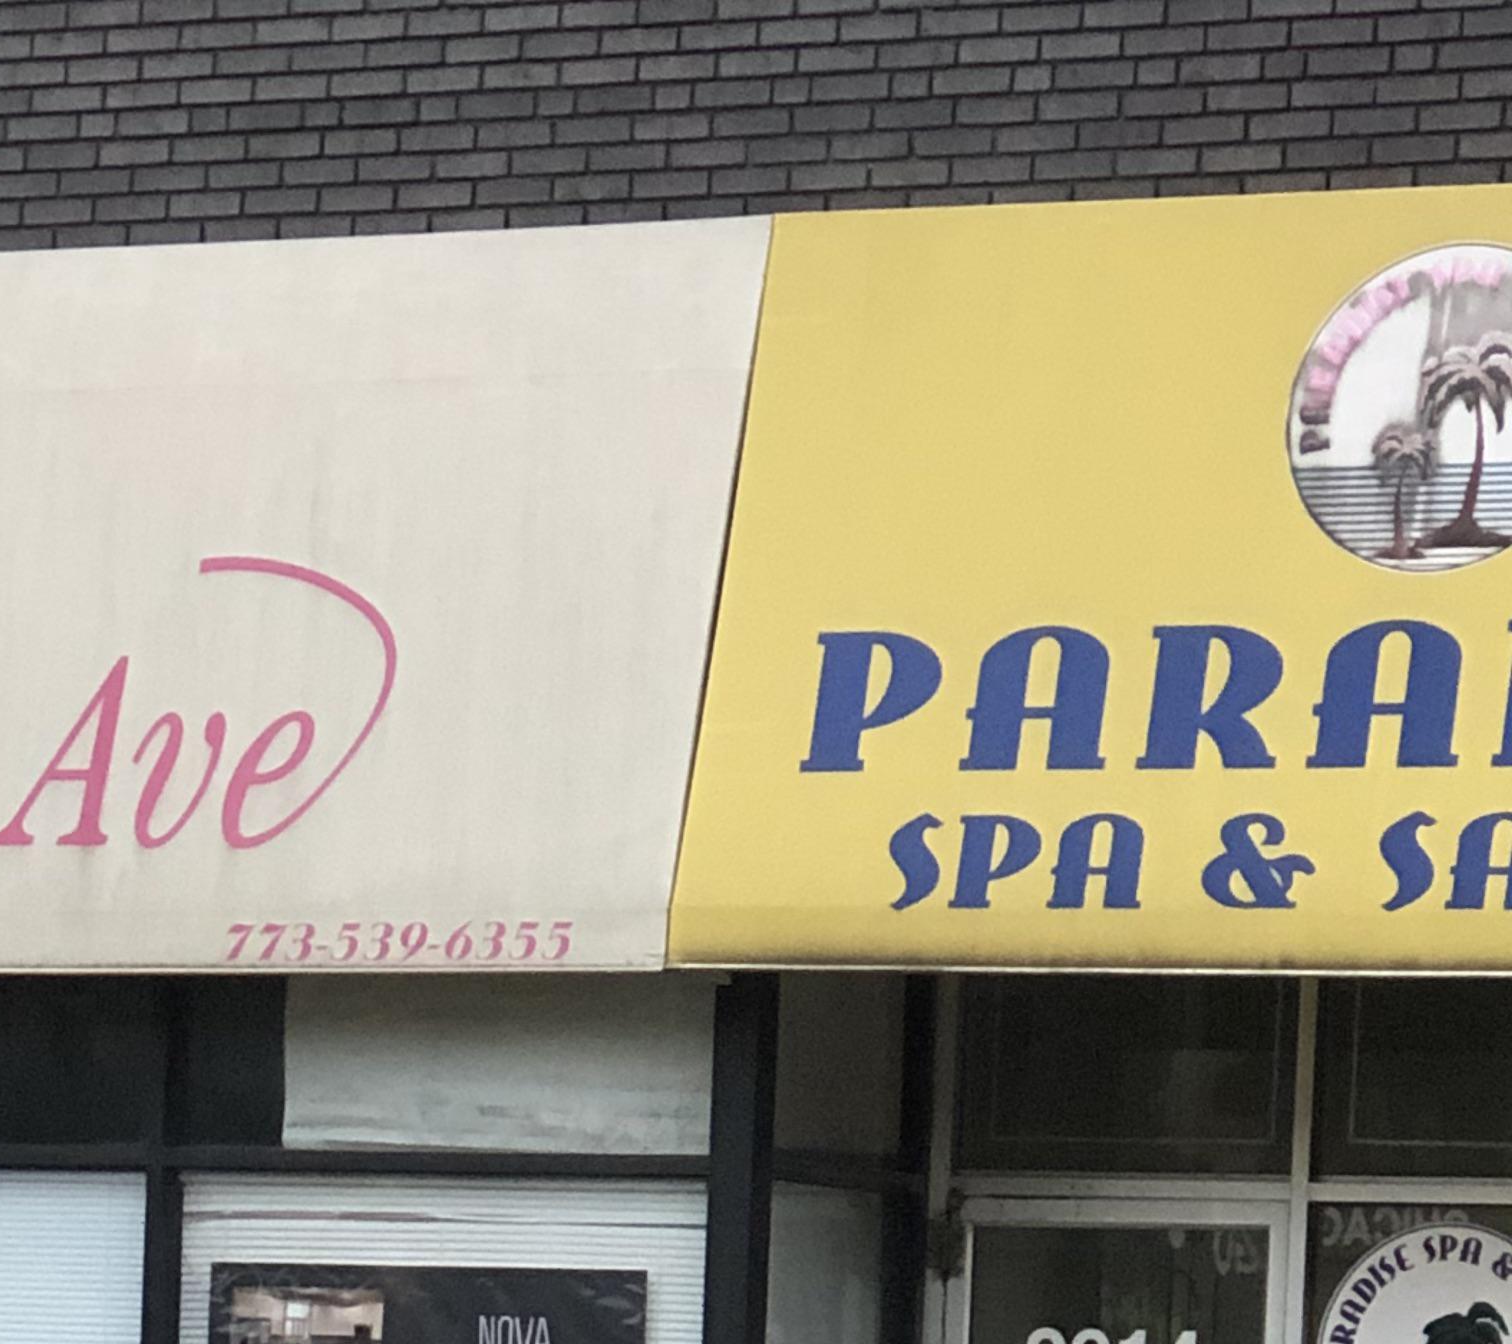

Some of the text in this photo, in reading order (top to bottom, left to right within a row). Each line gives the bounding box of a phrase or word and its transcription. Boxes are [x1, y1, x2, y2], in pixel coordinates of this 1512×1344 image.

[799, 620, 1512, 772] PARA
[888, 812, 1145, 911] SPA
[1200, 812, 1316, 909] &
[225, 920, 575, 963] 773-539-6355
[1422, 1234, 1483, 1267] SPA
